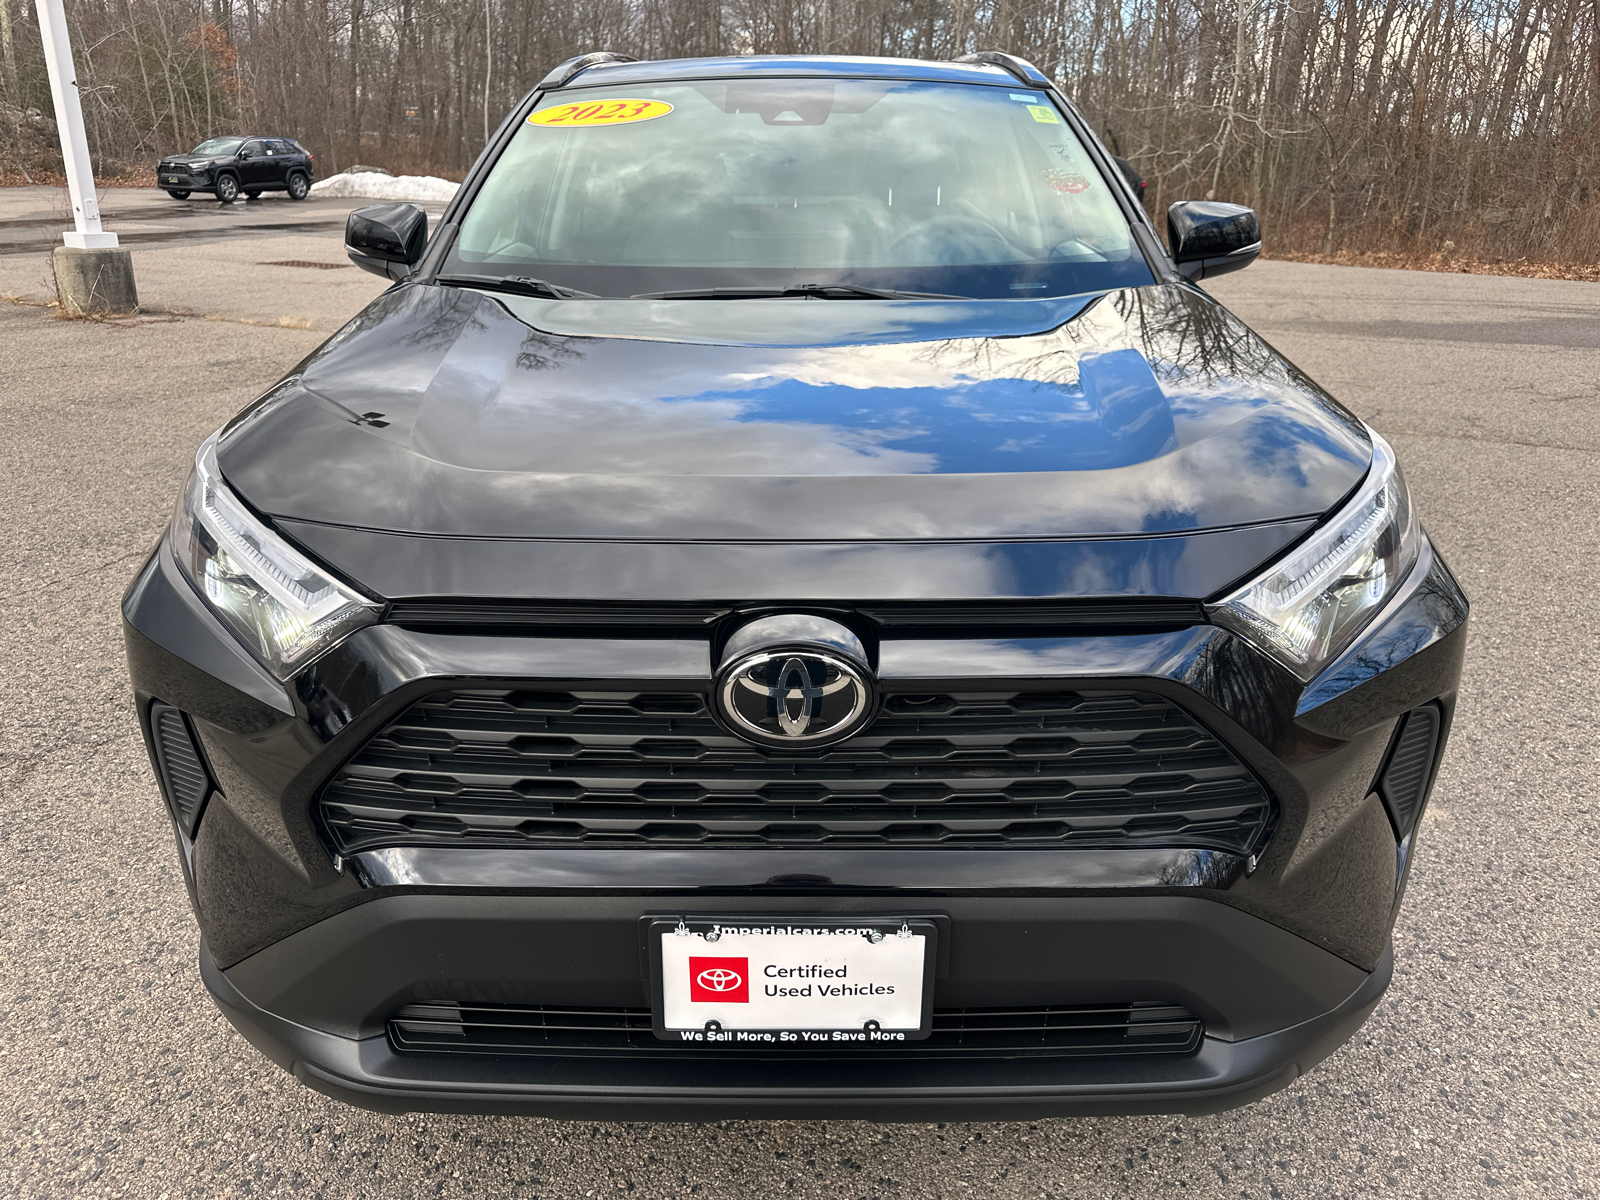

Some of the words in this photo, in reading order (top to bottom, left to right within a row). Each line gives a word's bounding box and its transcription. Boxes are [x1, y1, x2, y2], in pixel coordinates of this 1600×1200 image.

[546, 102, 652, 123] 2023
[713, 924, 873, 936] Imperialcars.com
[763, 964, 847, 979] Certified
[764, 983, 812, 997] Used
[817, 983, 895, 997] Vehicles
[680, 1031, 703, 1041] We
[706, 1031, 732, 1041] Sell
[737, 1031, 776, 1042] More,
[779, 1031, 798, 1041] So
[802, 1031, 828, 1041] You
[832, 1031, 866, 1041] Save
[870, 1031, 905, 1041] More
